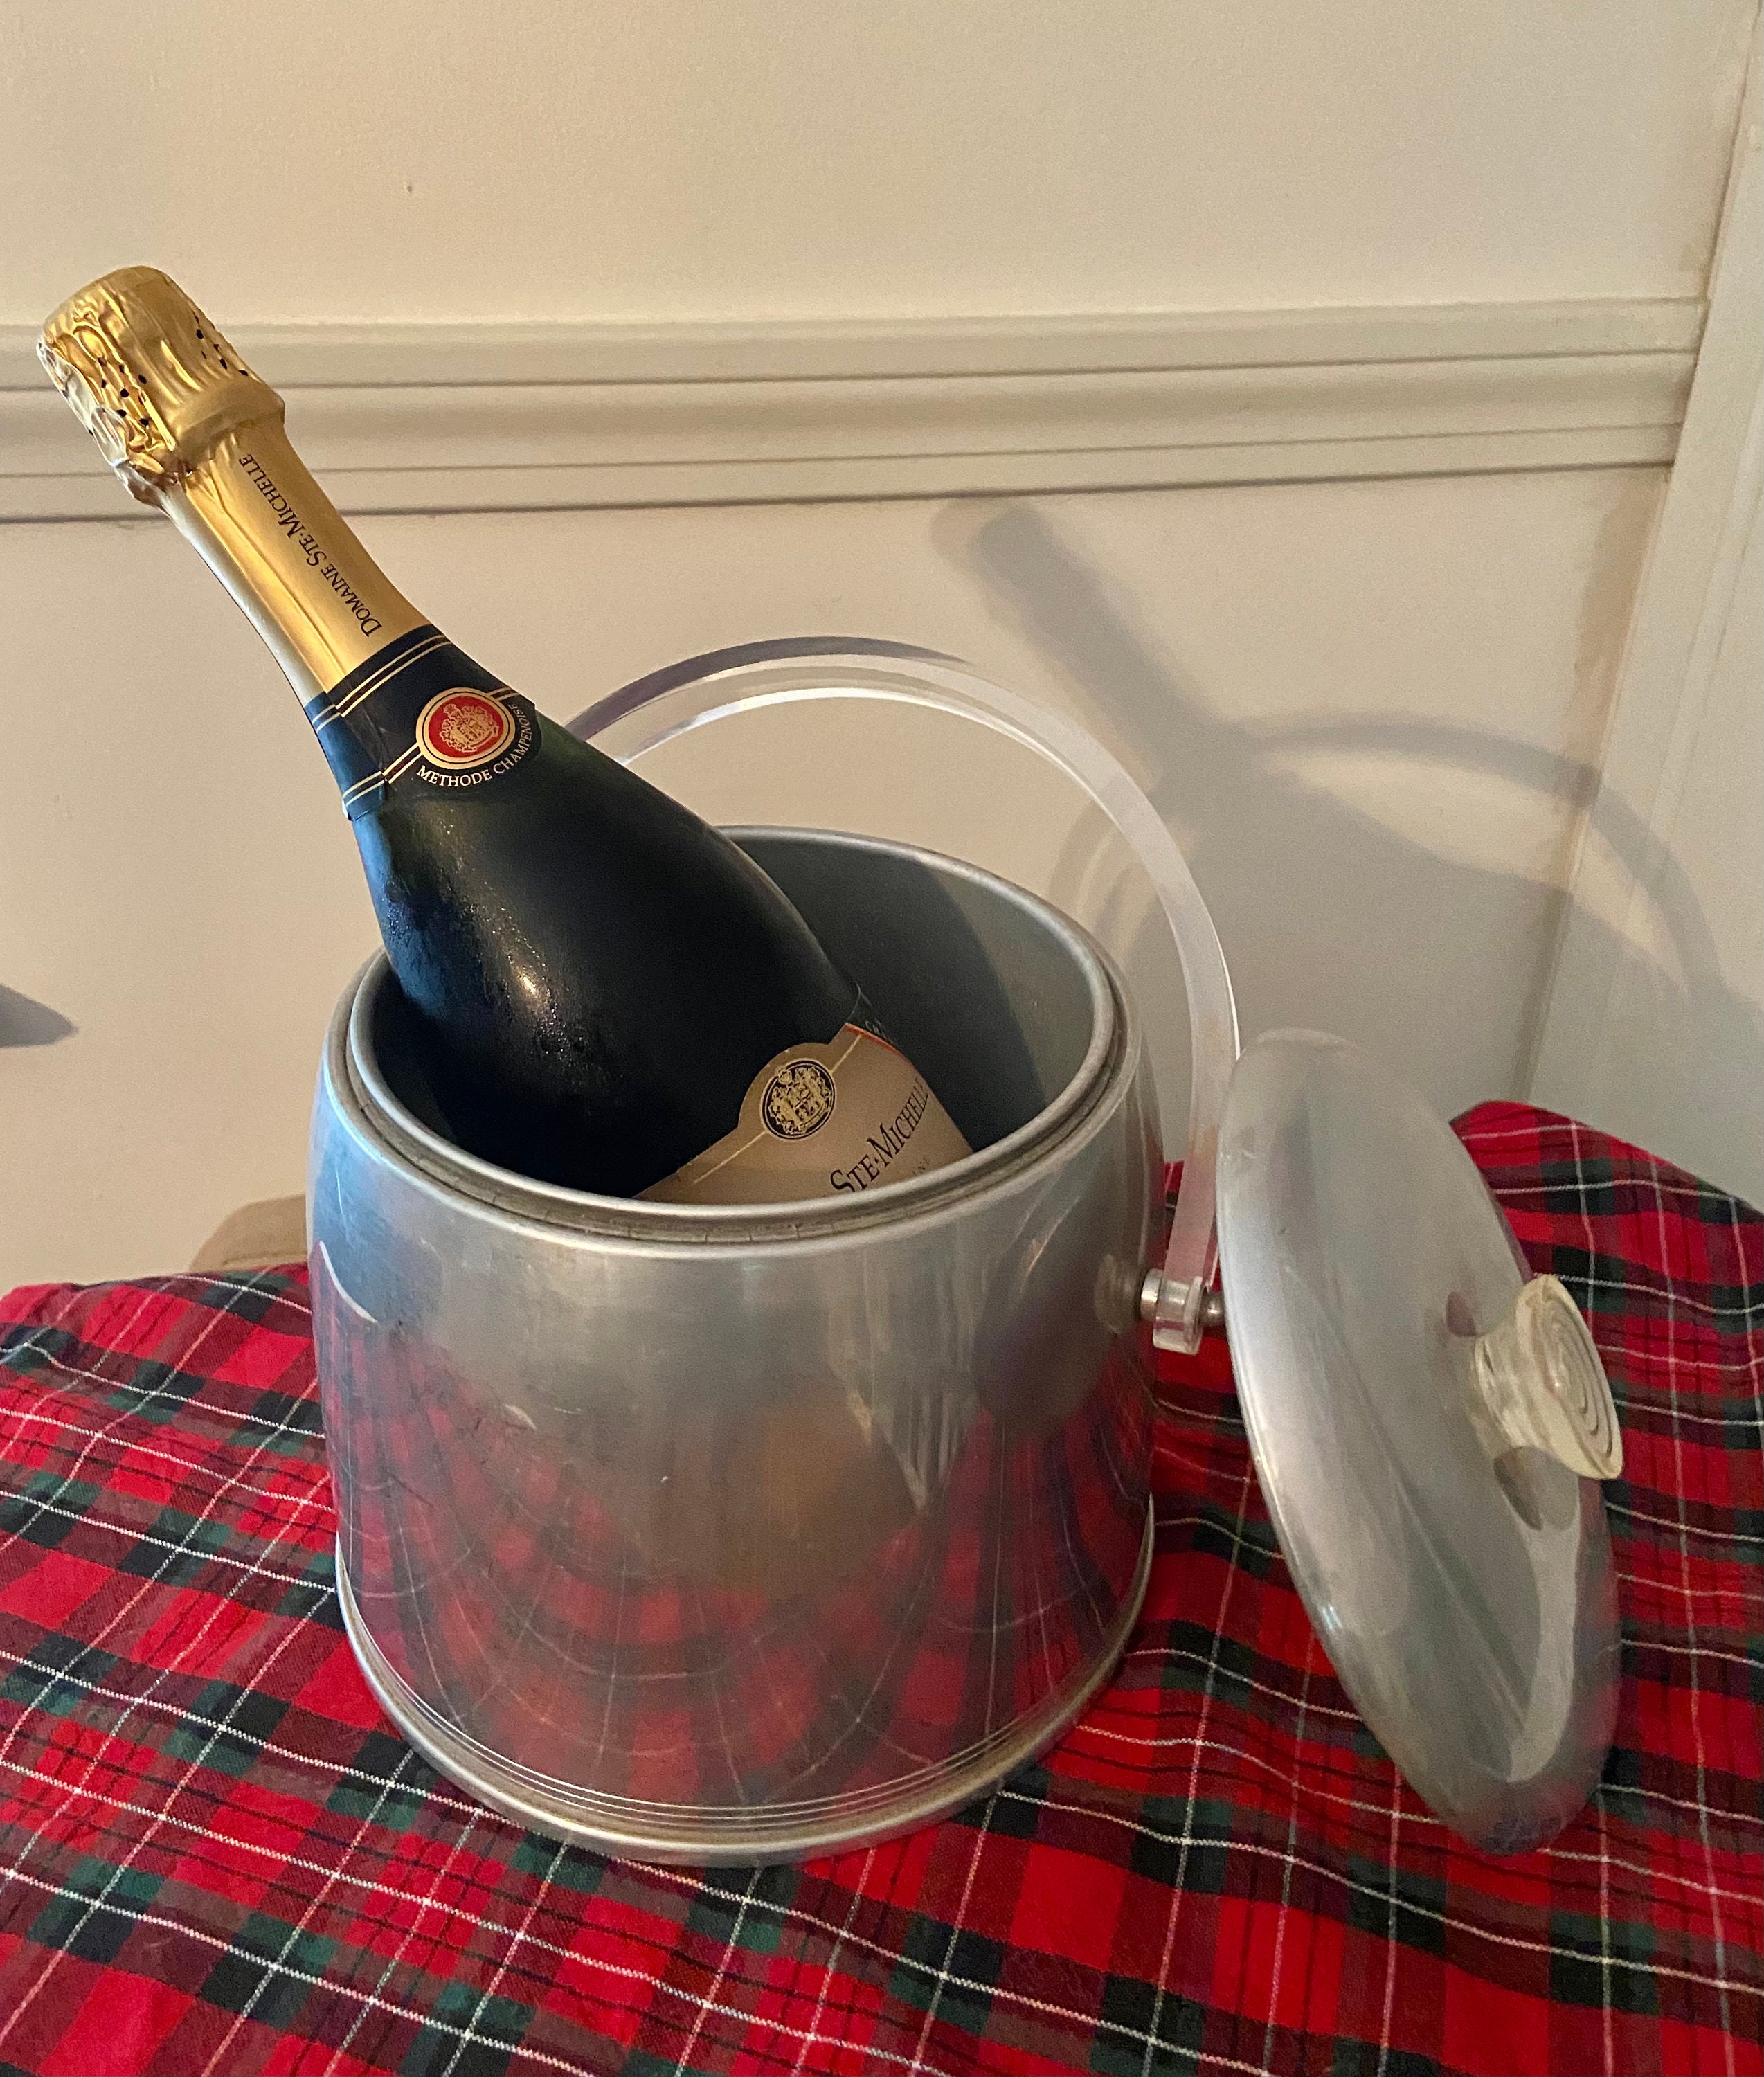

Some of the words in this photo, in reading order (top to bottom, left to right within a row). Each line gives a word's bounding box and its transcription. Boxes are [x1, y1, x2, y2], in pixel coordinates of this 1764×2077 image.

[321, 564, 382, 637] DOMAINE
[416, 765, 492, 787] METHODE
[493, 703, 532, 774] CHAMPENOISE
